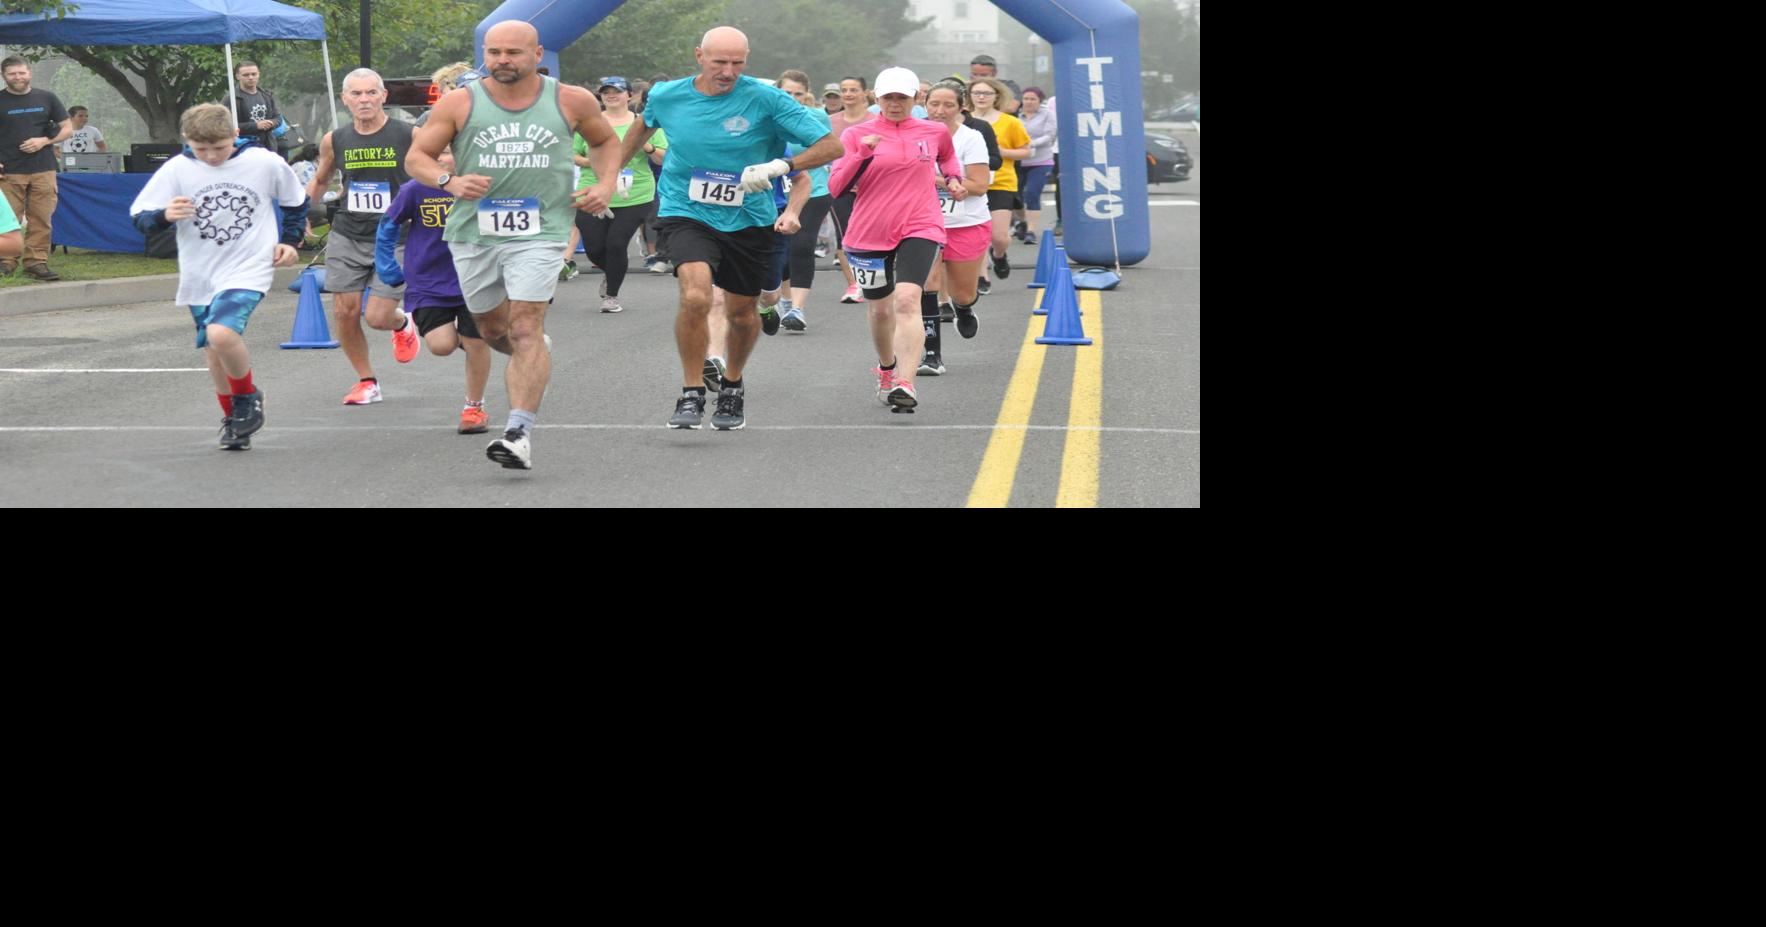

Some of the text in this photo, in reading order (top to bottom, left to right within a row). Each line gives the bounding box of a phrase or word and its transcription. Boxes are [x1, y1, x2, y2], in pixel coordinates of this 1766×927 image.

[473, 122, 560, 149] OCEAN CITY
[1075, 56, 1125, 220] TIMING
[344, 147, 382, 161] FACTORY
[478, 153, 550, 169] MARYLAND
[353, 192, 383, 210] 110
[701, 182, 737, 202] 145
[490, 210, 530, 232] 143
[851, 267, 877, 286] 137
